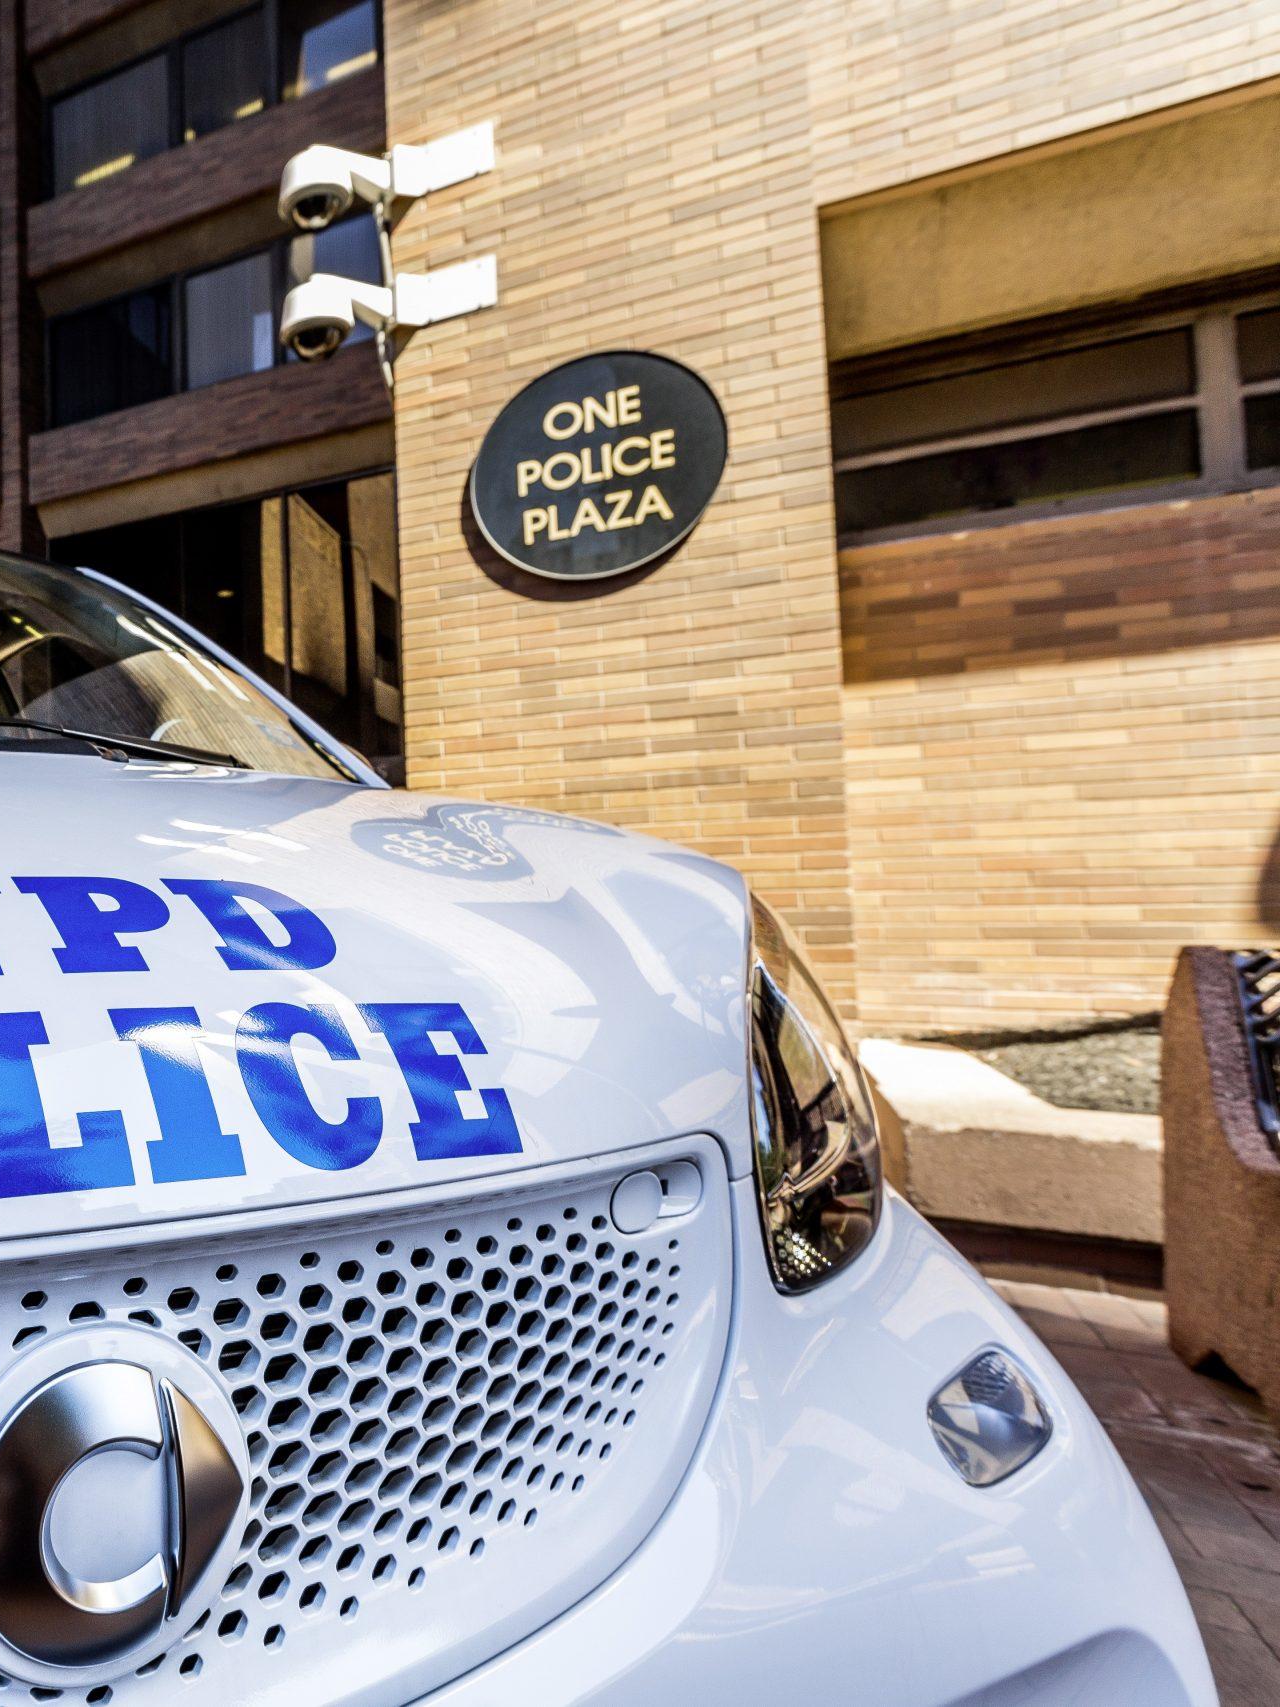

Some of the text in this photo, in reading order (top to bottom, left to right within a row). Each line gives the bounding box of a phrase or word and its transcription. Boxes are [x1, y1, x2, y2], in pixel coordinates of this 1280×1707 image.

[543, 385, 642, 440] ONE
[517, 429, 676, 497] POLICE
[522, 485, 674, 545] PLAZA
